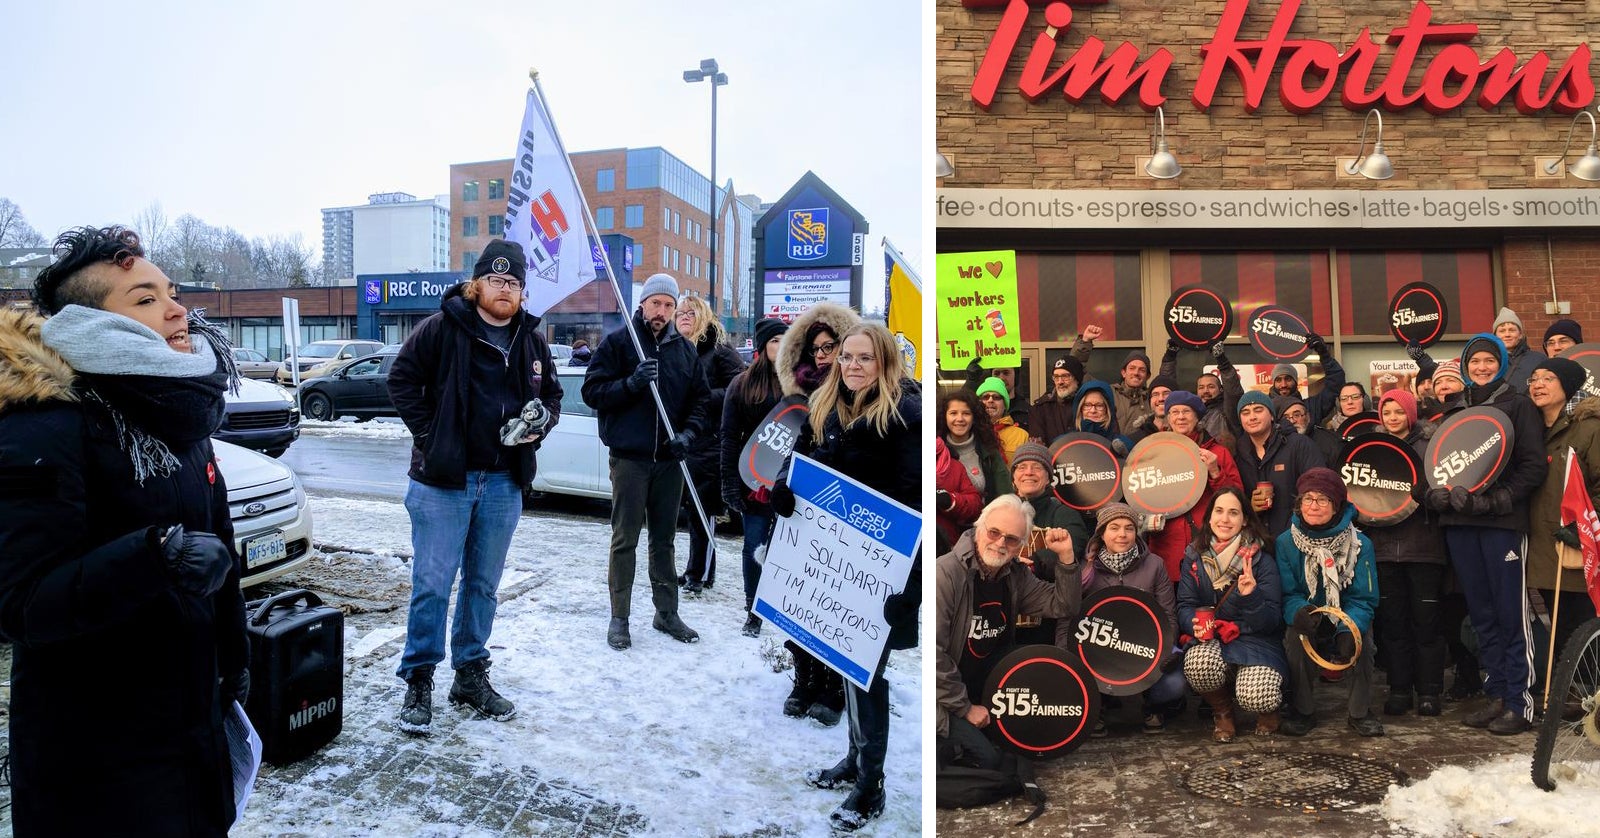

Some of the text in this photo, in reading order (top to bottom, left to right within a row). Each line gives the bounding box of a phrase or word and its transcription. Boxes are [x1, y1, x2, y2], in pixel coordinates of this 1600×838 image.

[962, 0, 1596, 115] Tim Hortons
[936, 195, 1600, 222] fee donuts espresso sandwiches latte bagels smooth
[792, 244, 824, 256] RBC
[389, 279, 459, 299] RBC Roy
[947, 290, 1006, 308] workers
[966, 316, 984, 331] at
[1168, 306, 1193, 324] $15
[1192, 316, 1223, 325] FAIRNESS
[1251, 317, 1277, 335] $15
[1392, 311, 1412, 329] $15
[1411, 313, 1439, 323] FAIRNESS
[1275, 330, 1307, 344] FAIRNESS
[946, 339, 1016, 358] Tim Hortons
[1372, 362, 1417, 371] Your Latte,
[757, 421, 790, 451] $15
[1463, 432, 1502, 466] FAIRNESS
[1051, 466, 1083, 488] $15 &
[1076, 470, 1116, 483] FAIRNESS
[1156, 471, 1195, 486] FAIRNESS
[1341, 463, 1378, 487] $15 &
[1433, 450, 1469, 485] $15 &
[1128, 469, 1163, 493] $15 &
[1370, 478, 1412, 492] FAIRNESS
[847, 513, 886, 540] SEFPO
[851, 503, 892, 530] OPSEU
[779, 521, 799, 547] IN
[861, 540, 894, 568] 454
[804, 562, 843, 592] WITH
[769, 561, 881, 641] TIM HORTONS
[782, 595, 854, 652] WORKERS
[1074, 616, 1120, 647] $15 &
[1109, 637, 1156, 659] FAIRNESS
[290, 697, 336, 731] MIPRO
[990, 689, 1039, 719] $15 &
[1031, 705, 1082, 716] FAIRNESS
